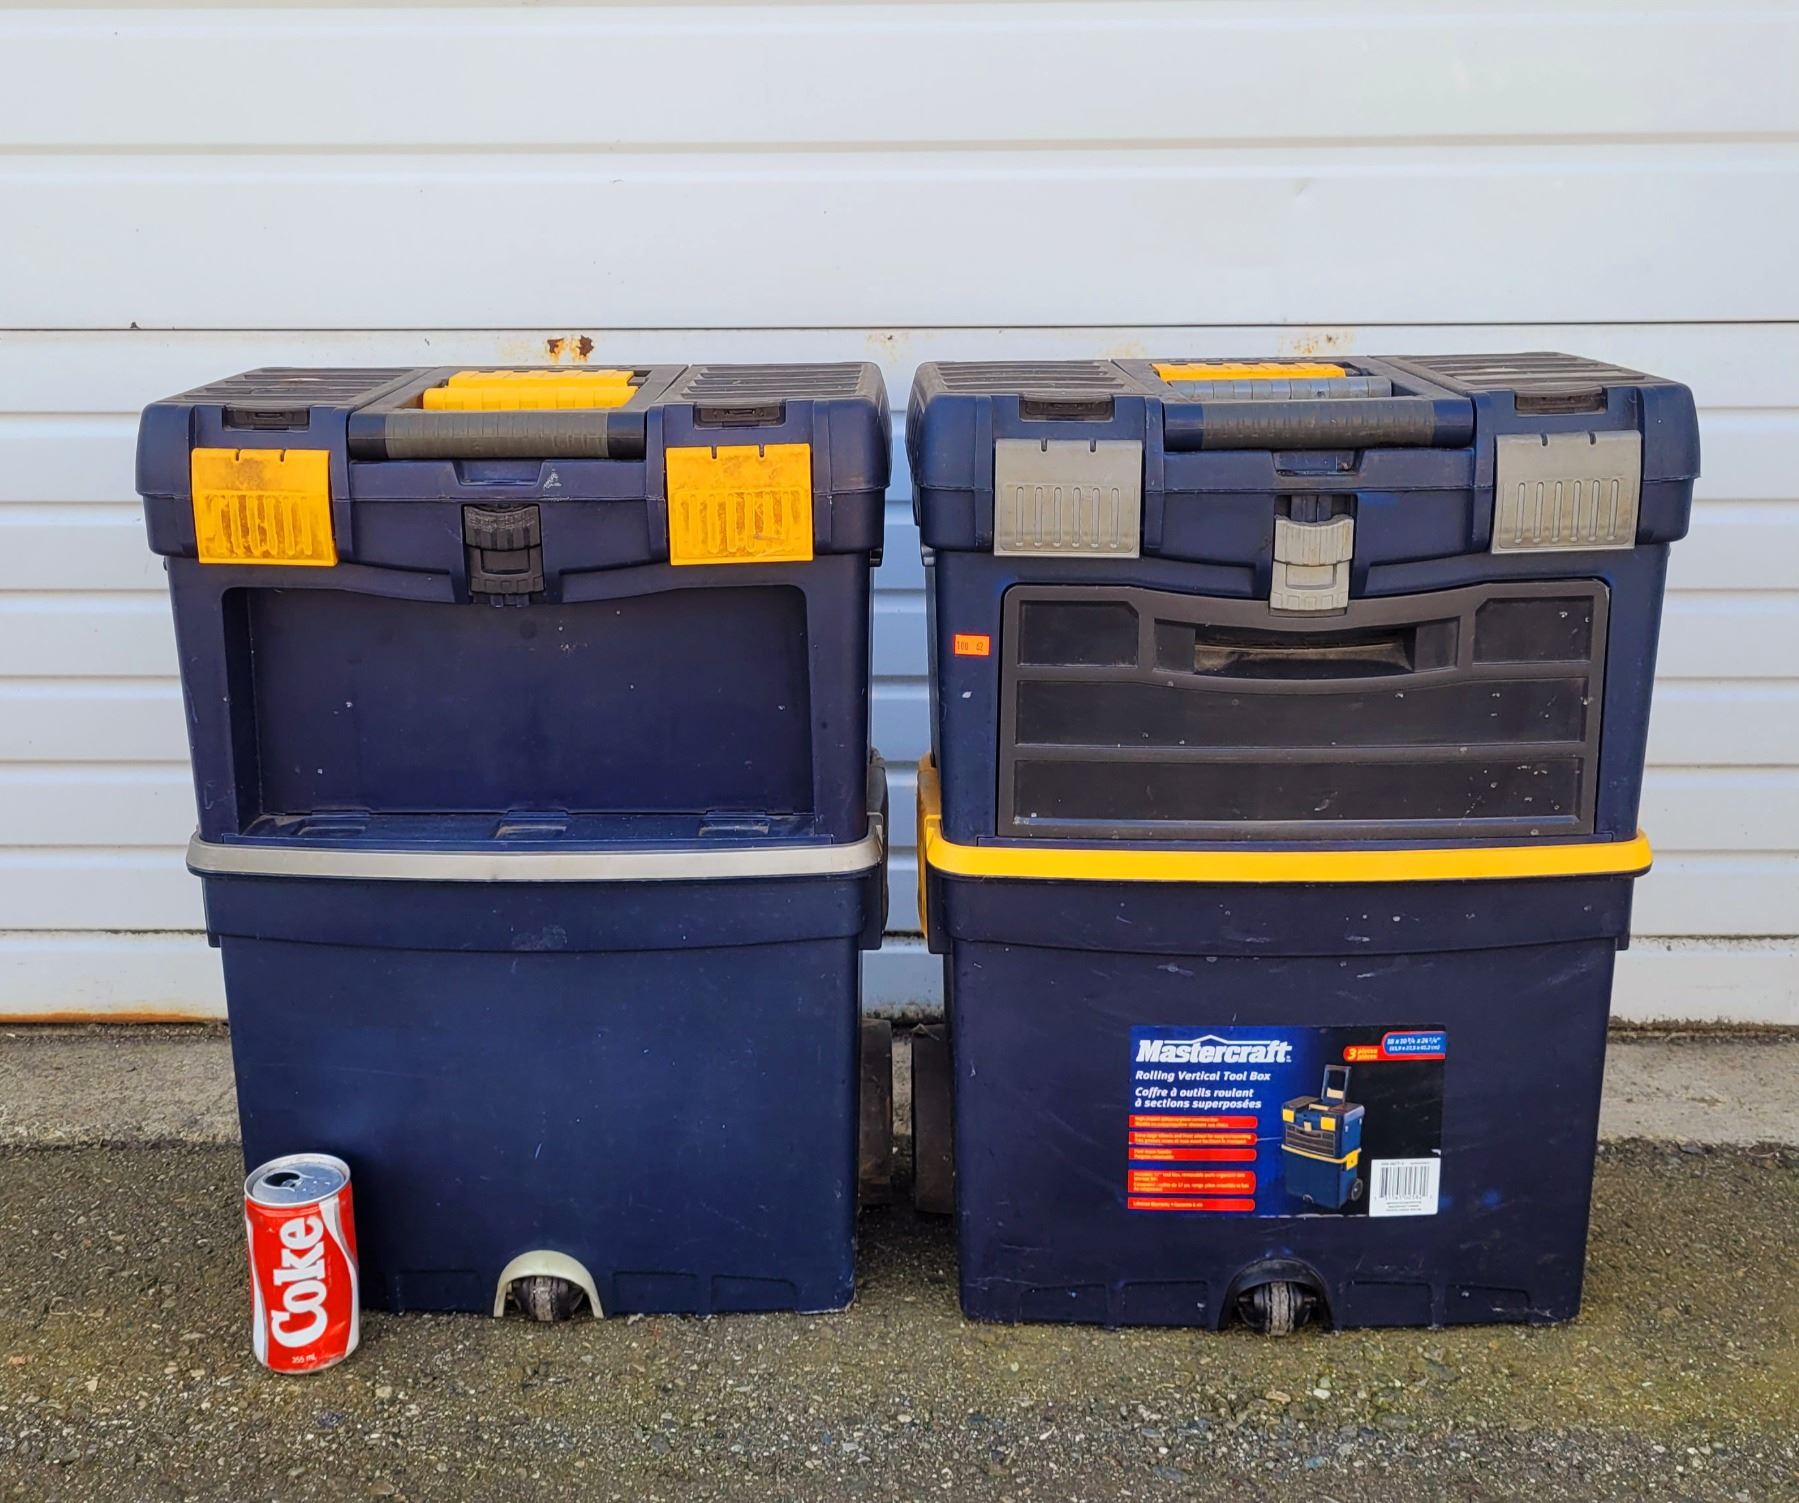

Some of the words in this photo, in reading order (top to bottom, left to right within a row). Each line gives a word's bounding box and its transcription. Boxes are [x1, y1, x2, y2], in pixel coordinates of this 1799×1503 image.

[1136, 1036, 1292, 1063] Mastercraft
[1347, 1048, 1357, 1060] 3
[1135, 1070, 1175, 1082] Rolling
[1178, 1070, 1220, 1081] Vertical
[1223, 1071, 1247, 1081] Tool
[1249, 1071, 1271, 1081] Box
[1135, 1087, 1168, 1099] Coffre
[1170, 1087, 1177, 1097] à
[1180, 1087, 1211, 1098] outils
[1213, 1088, 1254, 1098] roulant
[1135, 1098, 1142, 1108] à
[1144, 1098, 1190, 1109] sections
[1192, 1099, 1262, 1110] superposées
[271, 1216, 328, 1348] Coke
